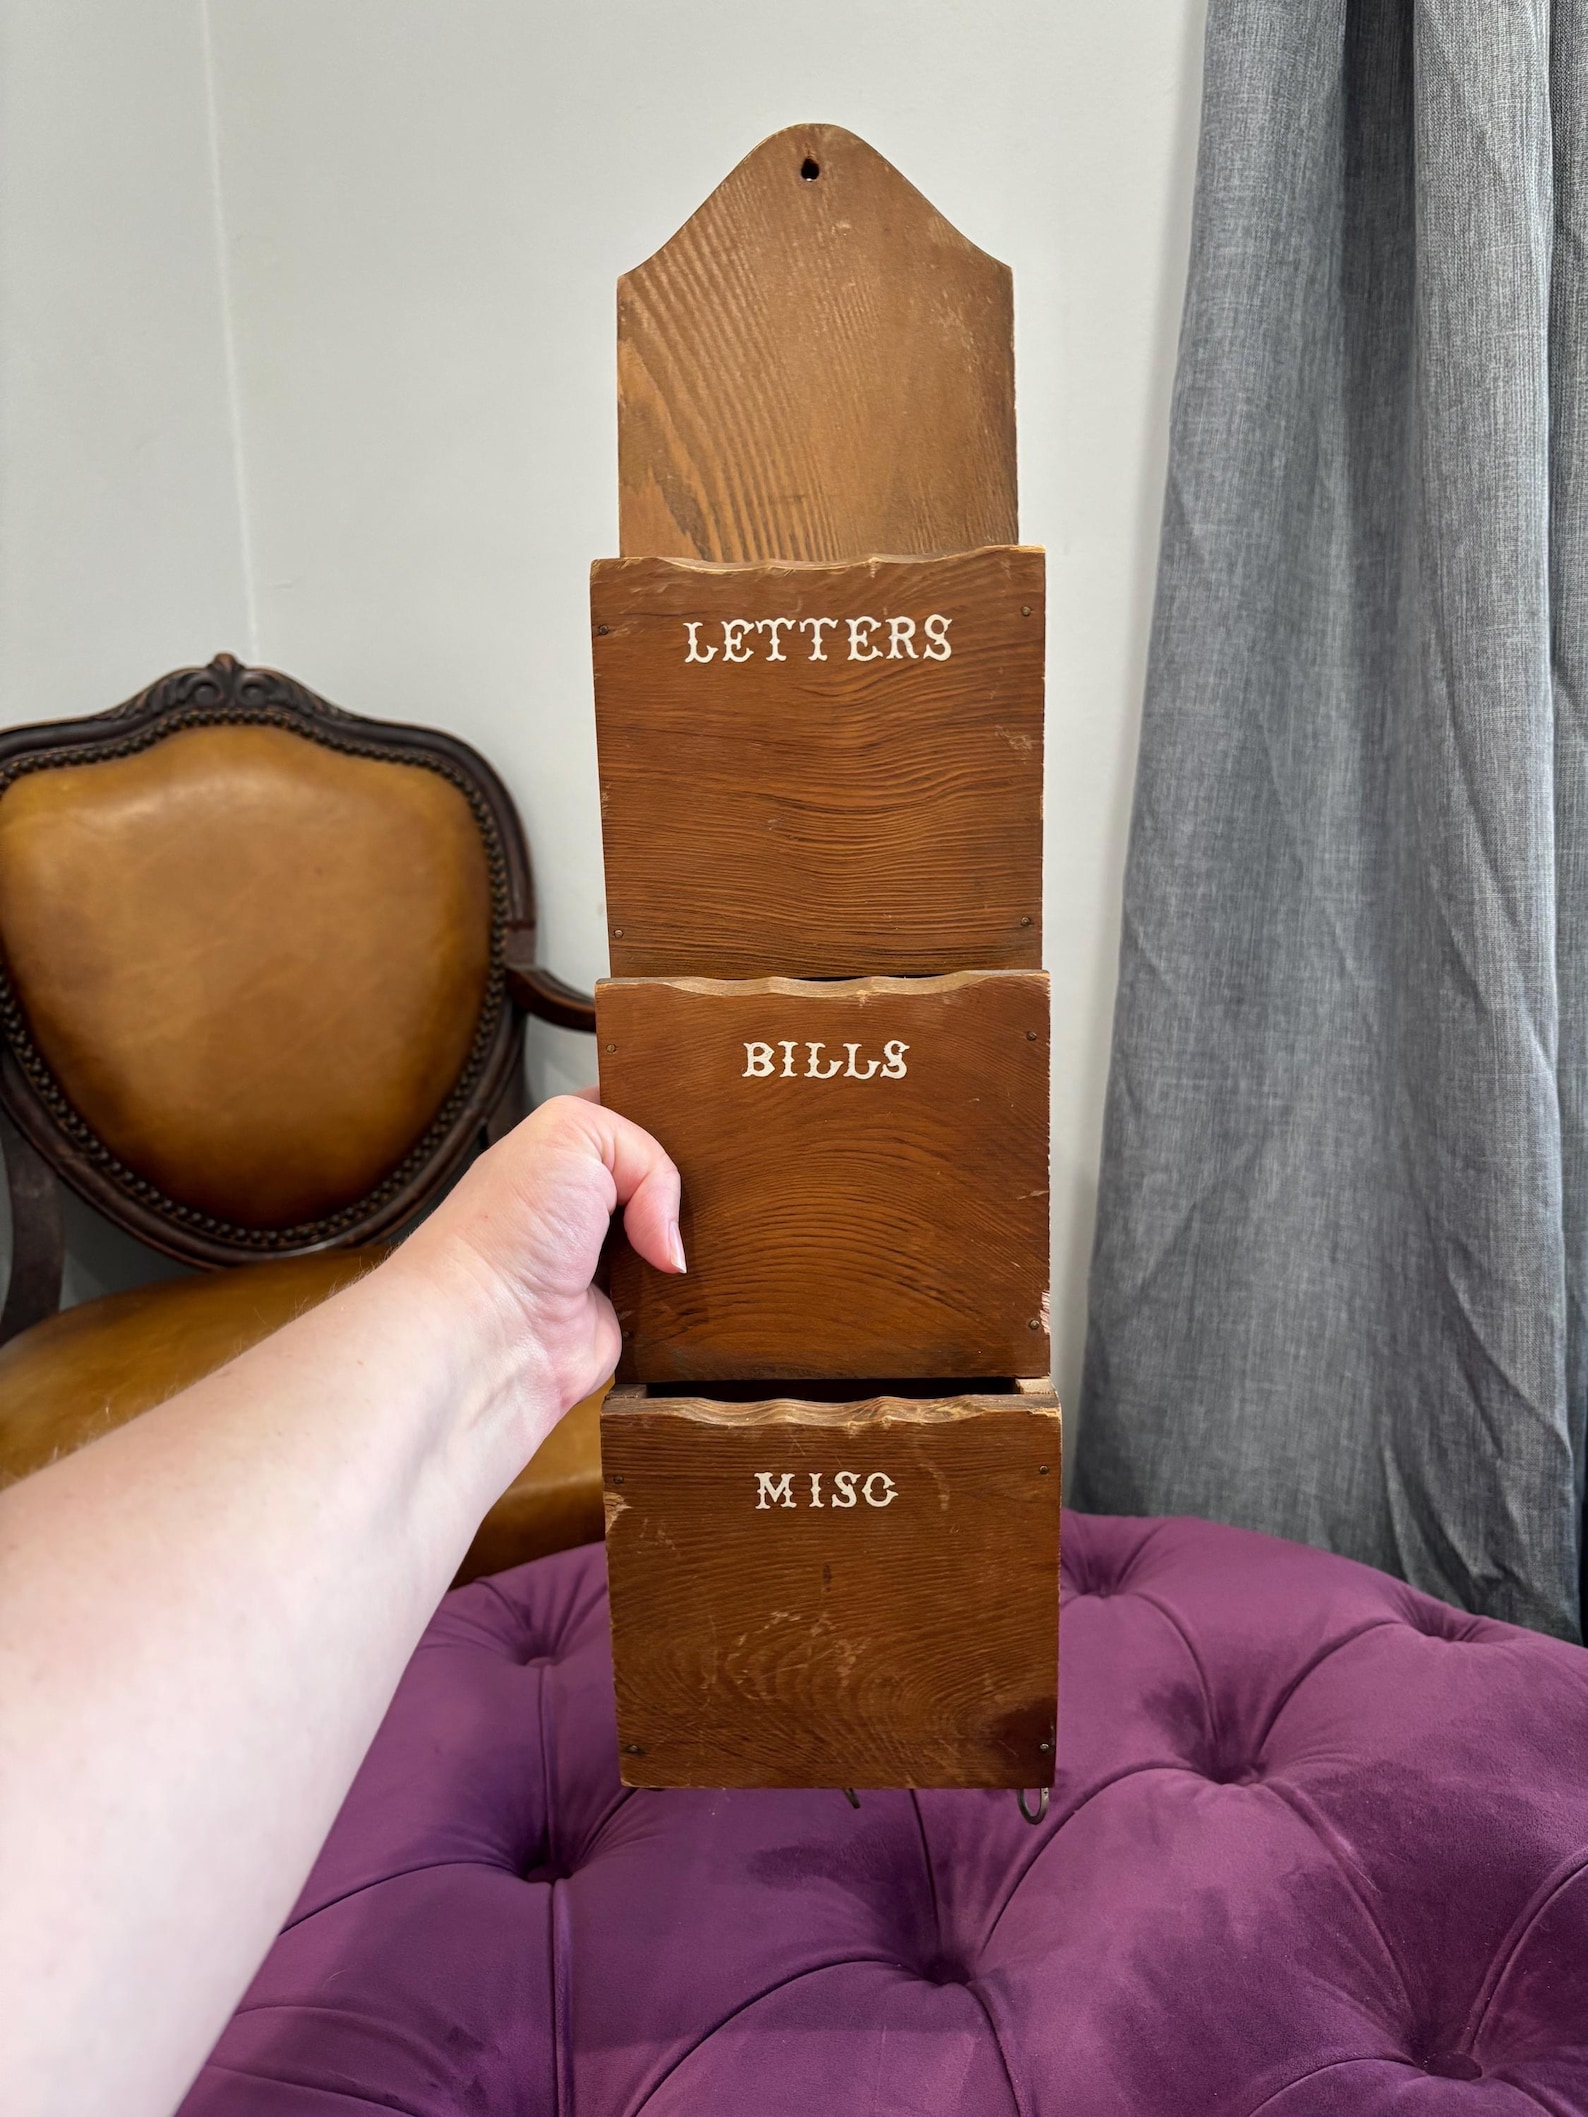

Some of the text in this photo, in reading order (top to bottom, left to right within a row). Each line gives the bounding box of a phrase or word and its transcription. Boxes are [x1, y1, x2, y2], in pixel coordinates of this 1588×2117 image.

[682, 613, 953, 664] LETTERS
[741, 1039, 911, 1080] BILLS
[753, 1471, 899, 1510] MISC
